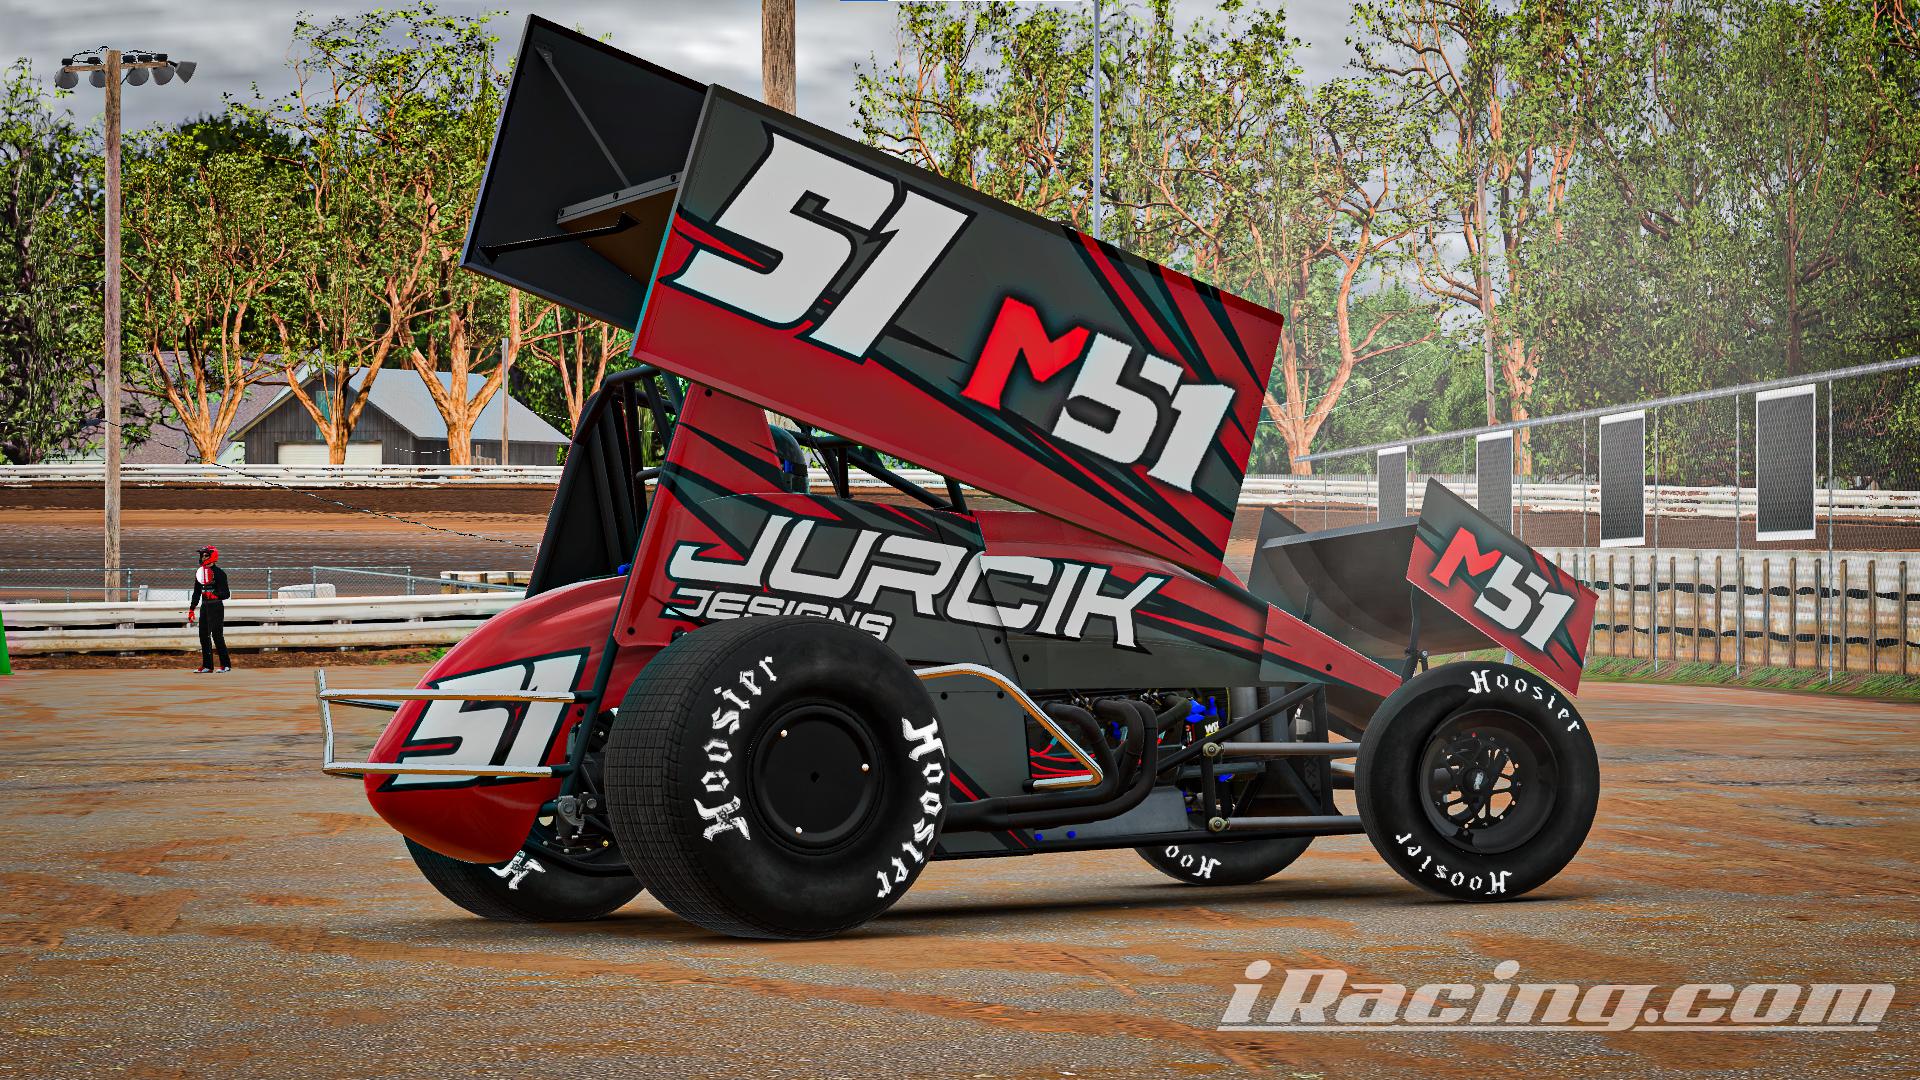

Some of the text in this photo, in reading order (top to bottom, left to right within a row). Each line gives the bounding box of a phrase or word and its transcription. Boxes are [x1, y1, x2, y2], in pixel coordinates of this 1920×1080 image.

[673, 131, 970, 360] 51
[961, 295, 1236, 492] M51
[664, 587, 894, 642] DESIGNS
[669, 514, 1164, 648] JURCIK
[1429, 526, 1575, 653] M51
[391, 653, 582, 786] 51
[693, 656, 778, 842] Hoosier
[1467, 669, 1582, 732] Hoosier
[876, 717, 946, 899] Hoosier
[1395, 832, 1513, 896] Hoosier
